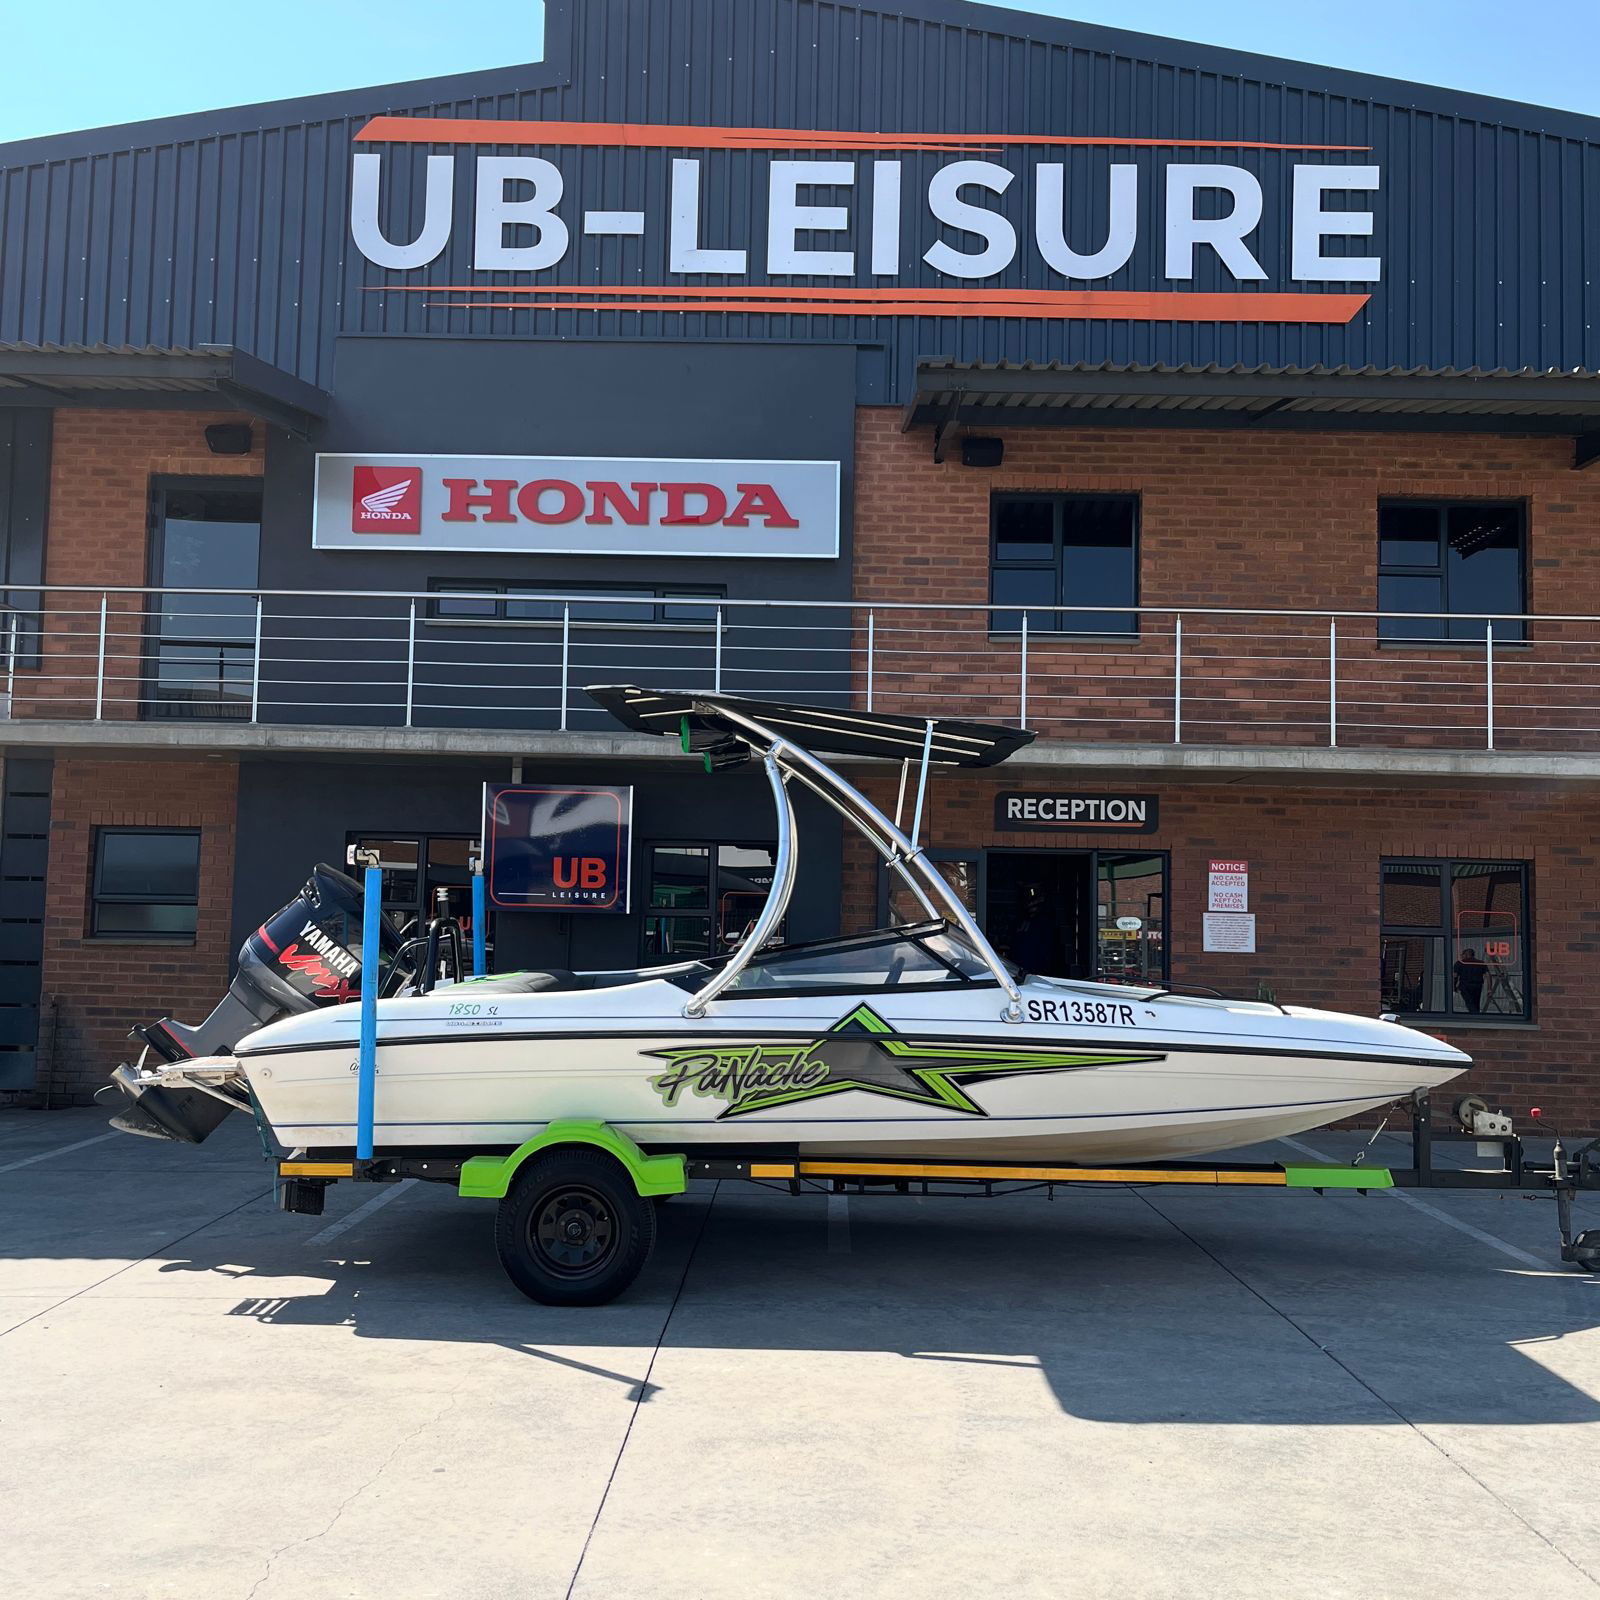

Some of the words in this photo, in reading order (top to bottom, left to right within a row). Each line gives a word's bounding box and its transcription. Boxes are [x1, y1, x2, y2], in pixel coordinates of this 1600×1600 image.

[350, 151, 1382, 283] UB-LEISURE
[442, 477, 800, 528] HONDA
[360, 511, 412, 520] HONDA
[1007, 797, 1147, 822] RECEPTION
[553, 856, 607, 889] UB
[1211, 863, 1246, 872] NOTICE
[552, 891, 606, 899] LEISURE
[299, 920, 359, 978] YAMAHA
[1486, 942, 1510, 956] UB
[449, 1002, 481, 1016] 1850
[1027, 999, 1137, 1026] SR13587R
